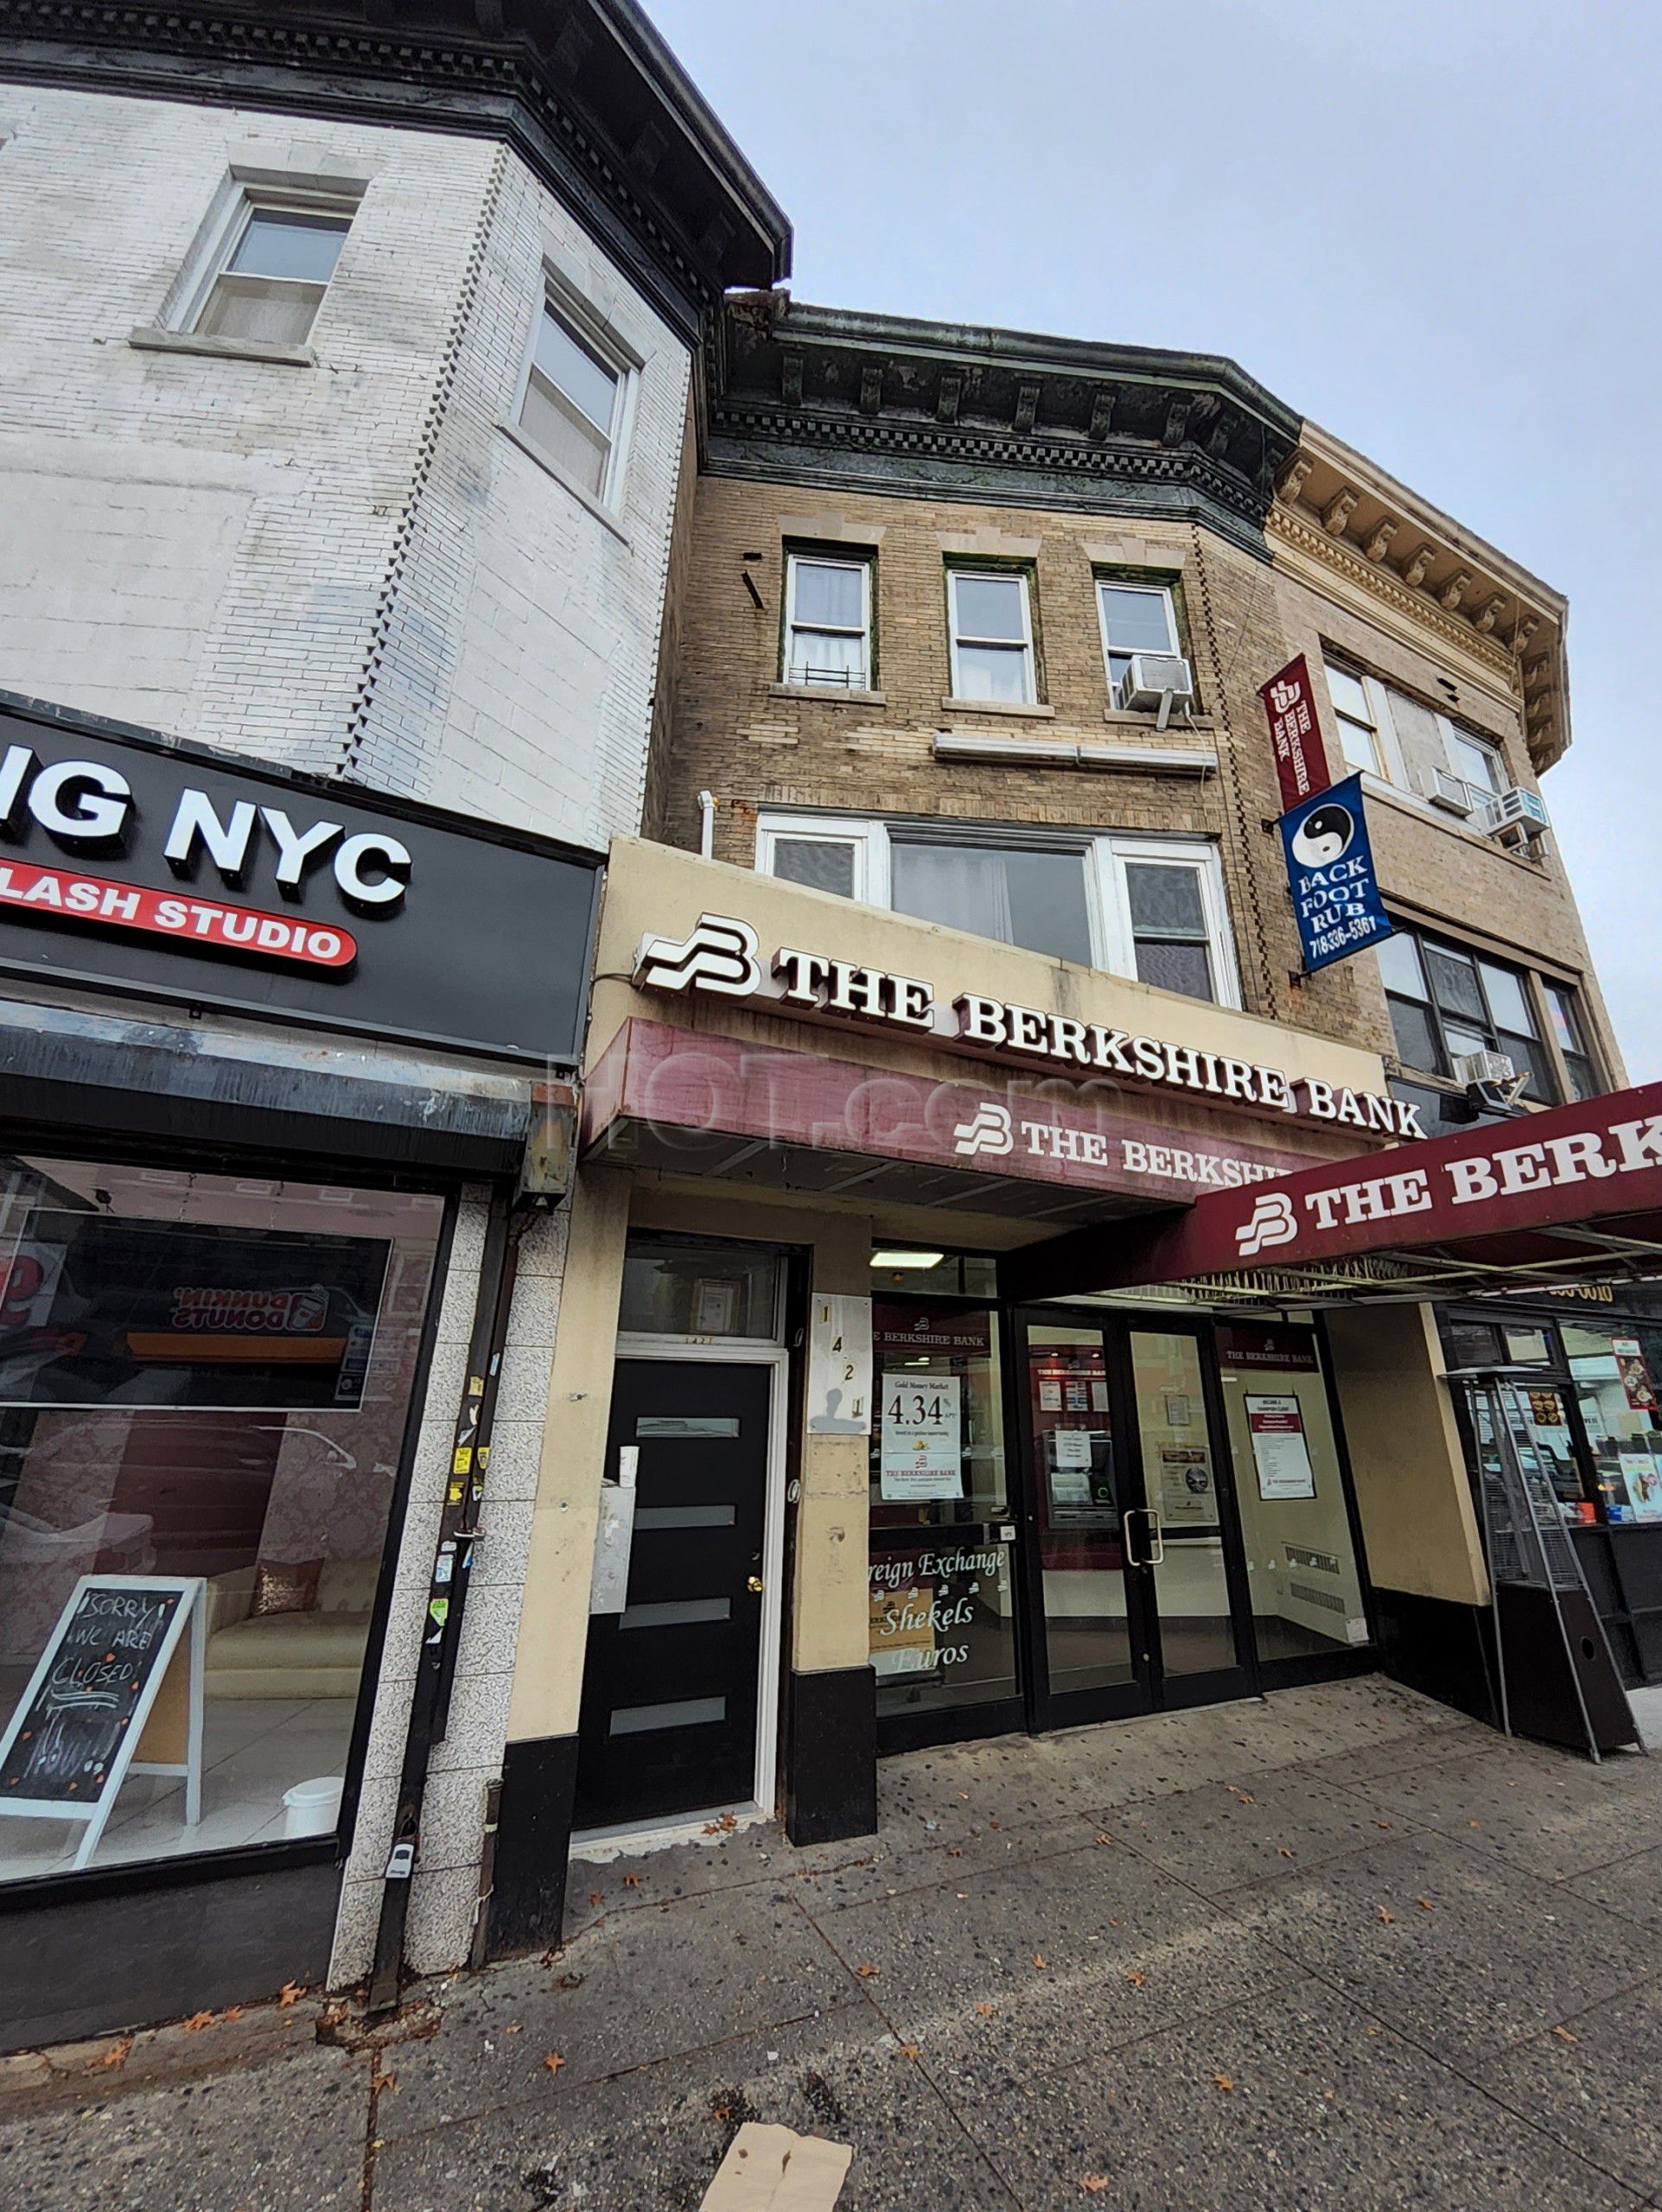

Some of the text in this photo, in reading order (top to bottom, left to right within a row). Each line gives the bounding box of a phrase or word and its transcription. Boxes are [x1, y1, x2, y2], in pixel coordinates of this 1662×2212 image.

[1296, 700, 1312, 735] THE
[1272, 716, 1289, 763] BANK
[1284, 712, 1311, 797] BERKSHIRE
[164, 788, 412, 903] NYC
[1298, 855, 1367, 896] BACK
[0, 868, 341, 959] LASH STUDIO
[1301, 878, 1369, 918] FOOT
[1310, 902, 1366, 934] RUB
[777, 947, 1429, 1139] THE BERKSHIRE BANK
[1021, 1120, 1107, 1166] THE
[1304, 1168, 1433, 1230] THE
[884, 1332, 951, 1345] BERKSHIRE
[953, 1336, 984, 1347] BANK
[888, 1394, 943, 1426] 4.34
[918, 1547, 1005, 1579] Exchange
[879, 1598, 975, 1636] Shekels
[891, 1644, 970, 1671] Euros
